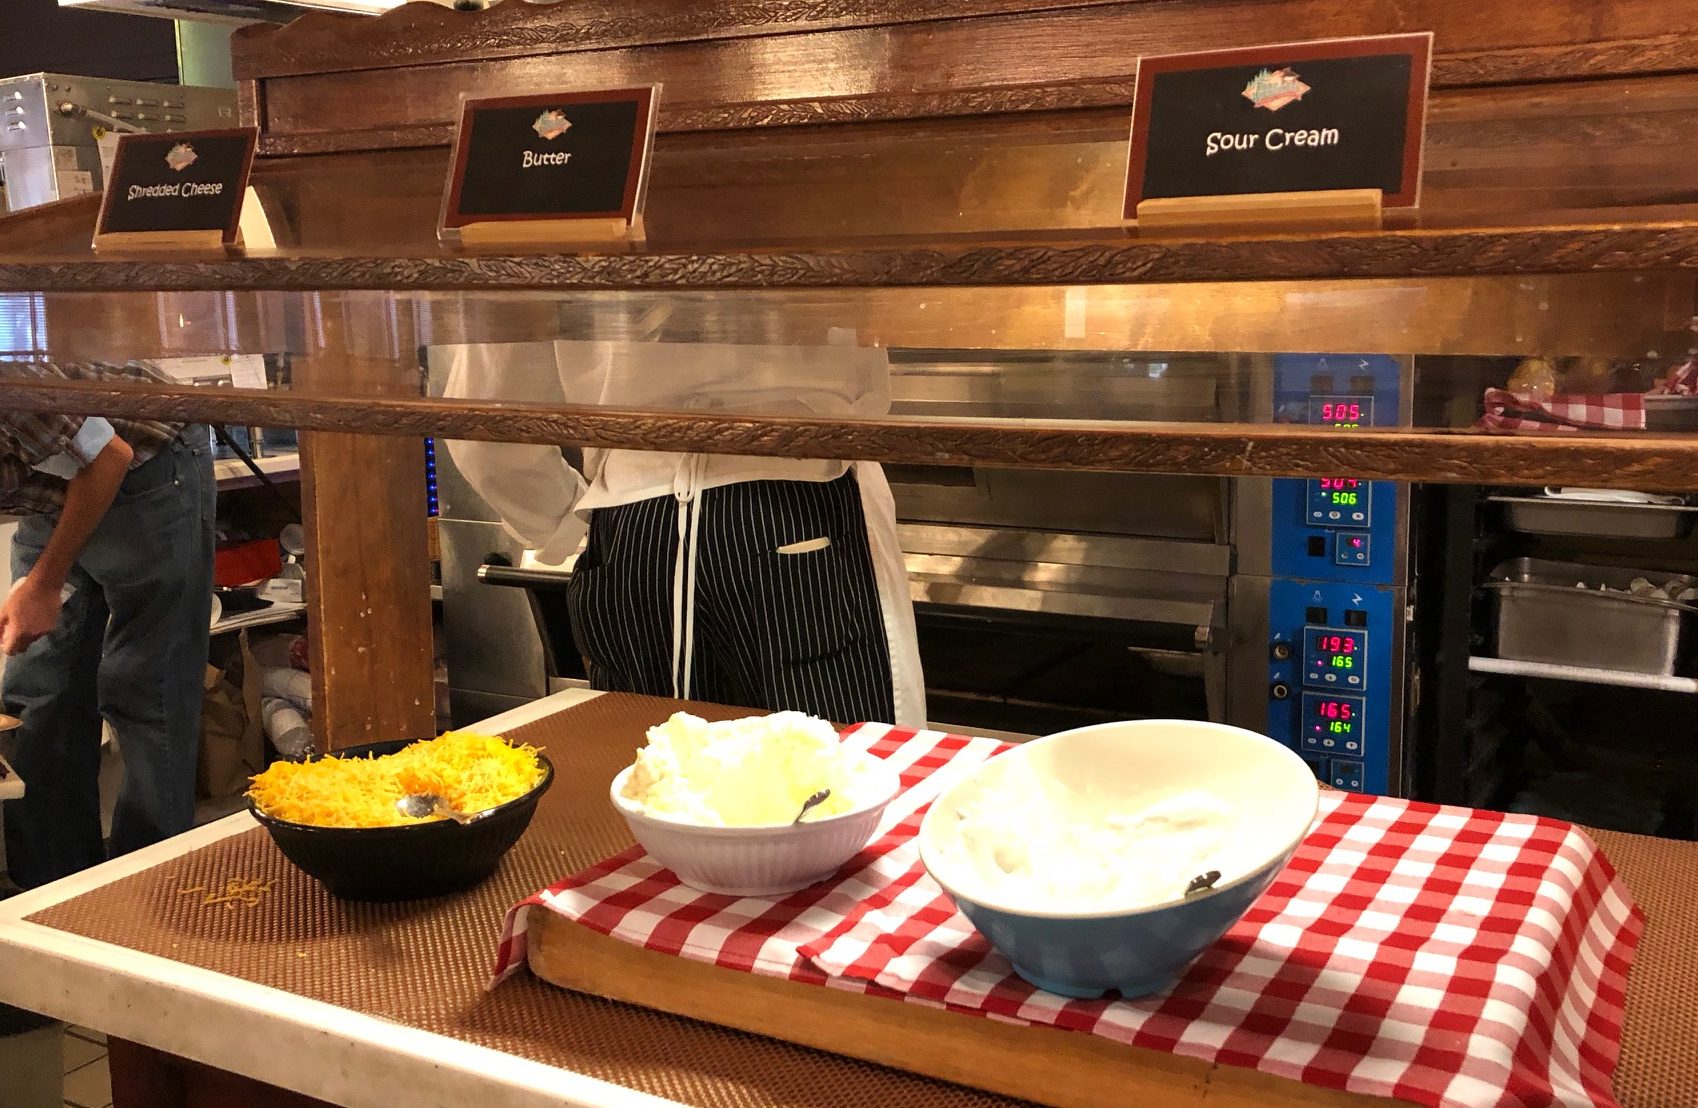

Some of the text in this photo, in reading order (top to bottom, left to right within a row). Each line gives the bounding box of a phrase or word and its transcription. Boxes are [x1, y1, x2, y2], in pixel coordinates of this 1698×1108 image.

[1206, 127, 1340, 156] Sour Cream
[522, 150, 571, 168] Butter
[127, 182, 223, 201] Shredded Cheese
[1322, 403, 1359, 421] 505
[1332, 492, 1357, 505] 506
[1321, 636, 1355, 654] 193
[1331, 656, 1353, 668] 165
[1320, 702, 1351, 719] 165
[1330, 721, 1351, 733] 164
